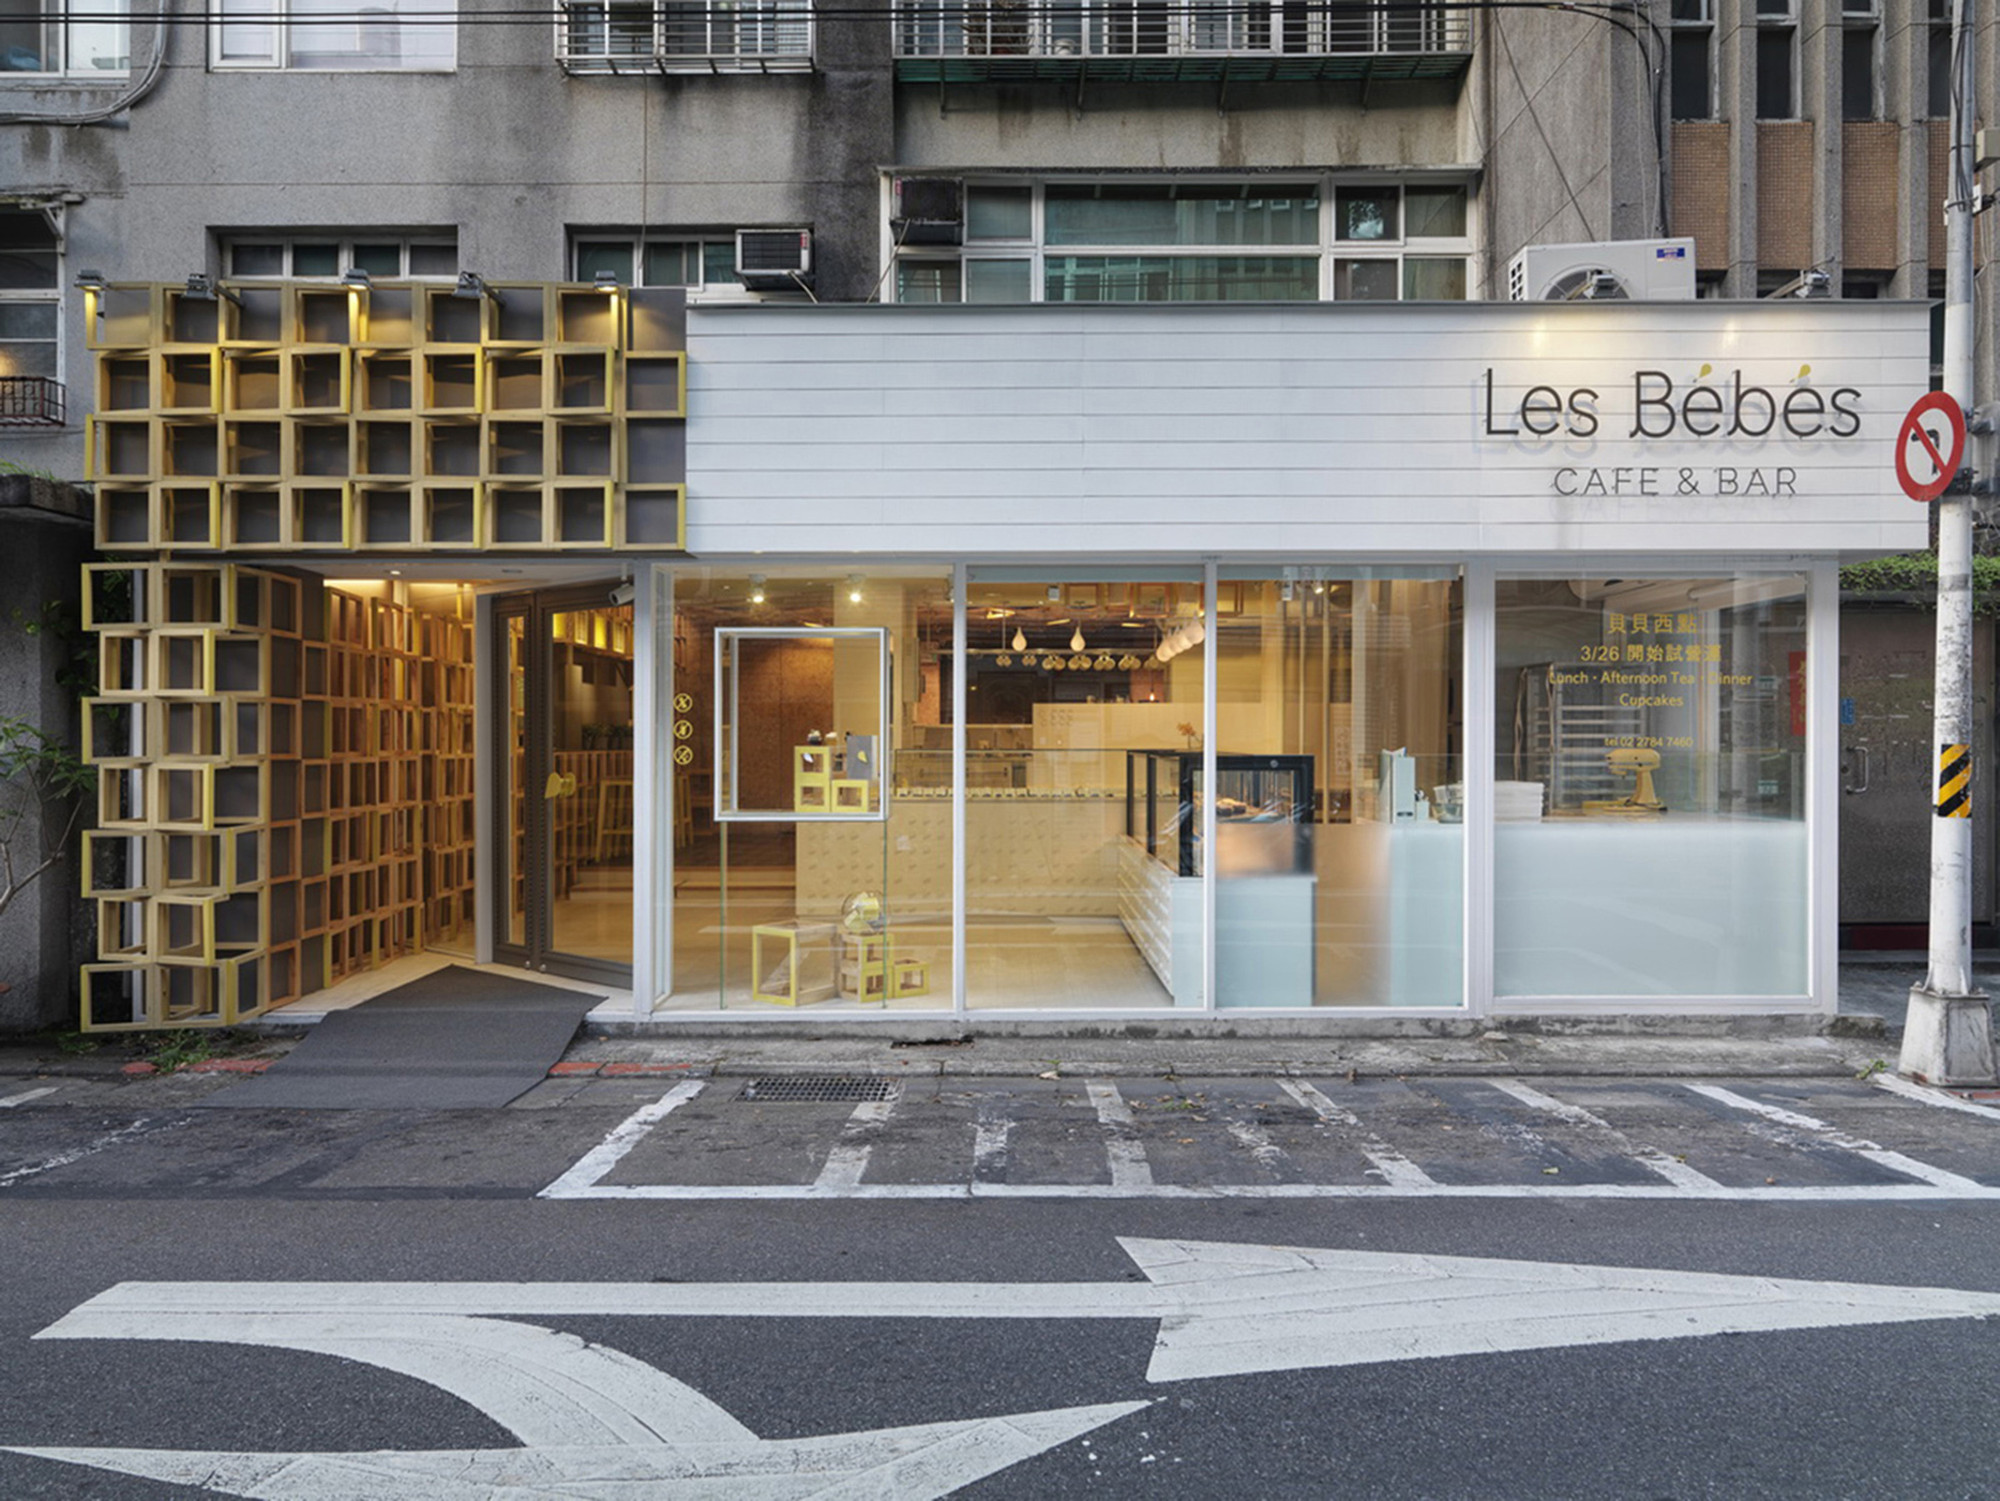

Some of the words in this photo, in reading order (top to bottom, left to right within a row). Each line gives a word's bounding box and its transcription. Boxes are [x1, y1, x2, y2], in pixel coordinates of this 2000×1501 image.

[1486, 367, 1600, 438] Les
[1629, 364, 1862, 438] Bébés
[1553, 467, 1660, 496] CAFE
[1677, 467, 1701, 496] &
[1717, 467, 1798, 497] BAR
[1607, 613, 1697, 634] 貝貝西點
[1580, 645, 1620, 662] 3/26
[1549, 671, 1589, 684] Lunch
[1600, 671, 1668, 684] Afternoon
[1670, 671, 1696, 684] Tea
[1707, 671, 1753, 684] Dinner
[1619, 693, 1684, 707] Cupcakes
